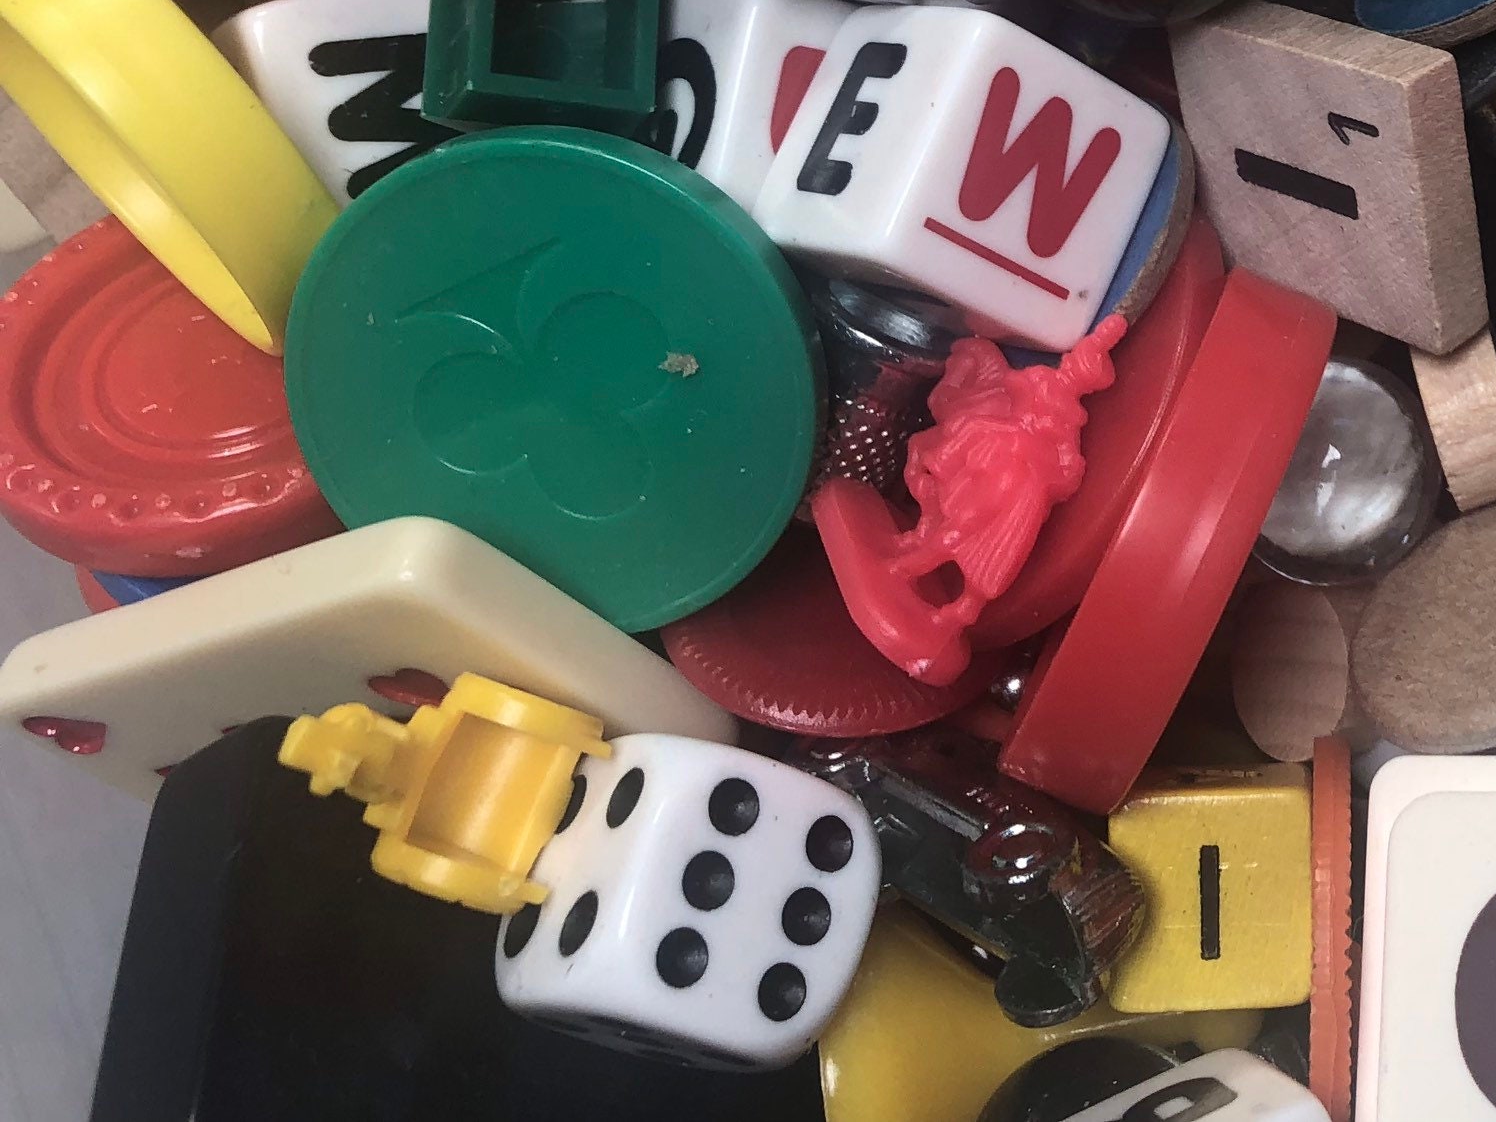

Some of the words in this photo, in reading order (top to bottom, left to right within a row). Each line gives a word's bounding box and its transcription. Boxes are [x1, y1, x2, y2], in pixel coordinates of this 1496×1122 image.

[797, 42, 907, 196] E
[958, 67, 1121, 258] W
[1235, 147, 1359, 220] I
[1328, 112, 1380, 145] 1
[1199, 844, 1220, 960] I
